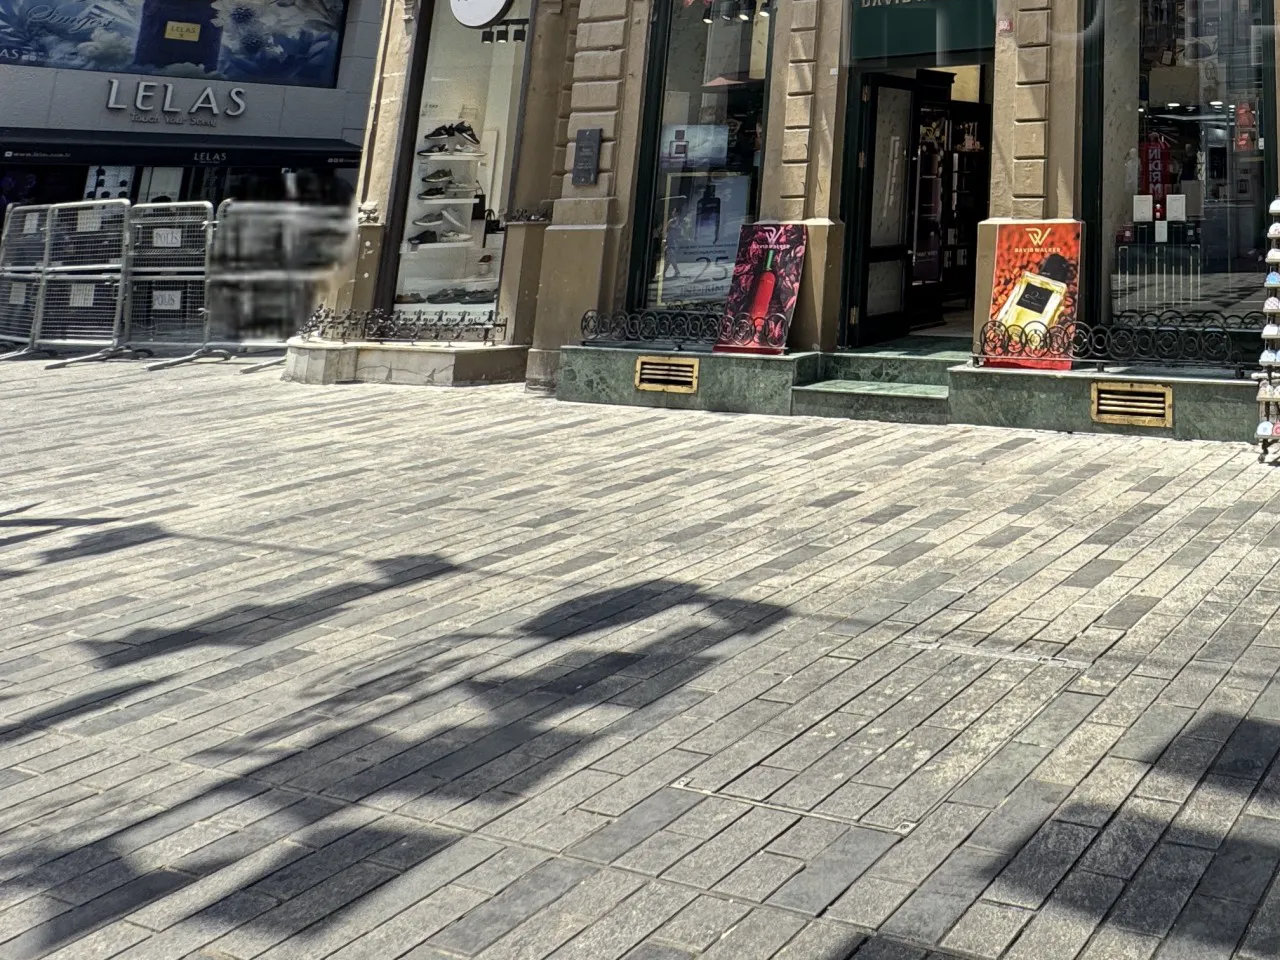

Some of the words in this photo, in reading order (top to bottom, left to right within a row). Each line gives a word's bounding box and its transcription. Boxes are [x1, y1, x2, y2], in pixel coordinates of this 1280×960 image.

[106, 79, 247, 118] LELAS
[193, 151, 227, 161] LELAS
[693, 256, 729, 283] 25
